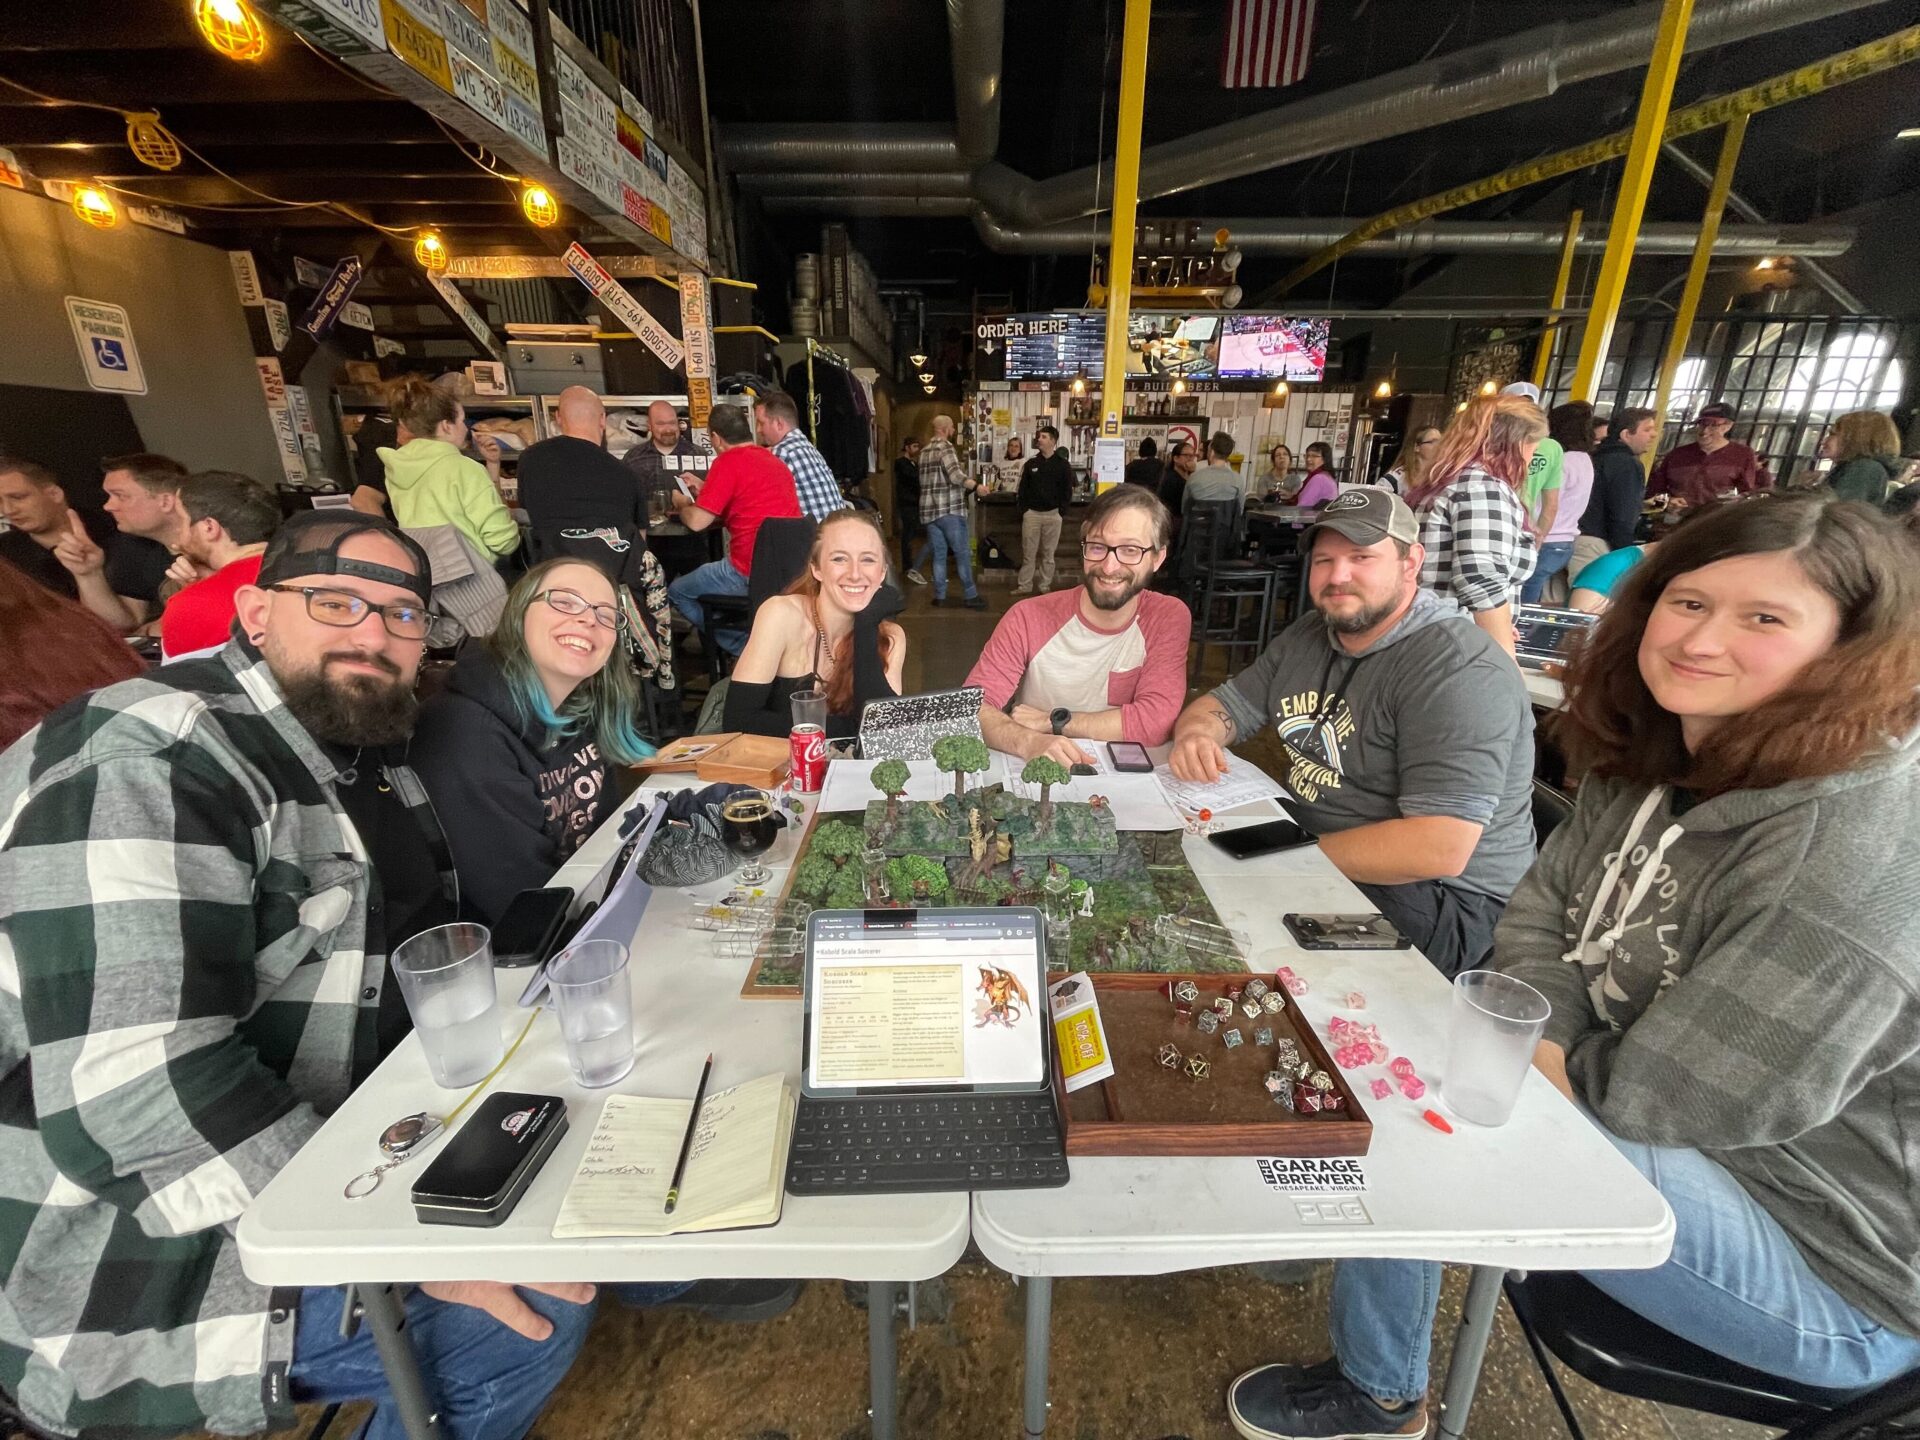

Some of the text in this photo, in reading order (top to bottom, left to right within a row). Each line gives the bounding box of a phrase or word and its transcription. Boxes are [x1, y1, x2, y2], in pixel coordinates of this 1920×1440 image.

[565, 249, 585, 273] ECB
[582, 266, 607, 291] 8097
[306, 262, 356, 333] Genuine Ford Parts
[72, 304, 123, 325] RESERVED
[80, 320, 125, 339] PARKING
[977, 319, 1068, 339] ORDER HERE
[260, 364, 277, 401] FARM
[271, 370, 285, 395] USE
[1188, 382, 1220, 392] BEER
[1141, 427, 1165, 437] ROADWAY
[857, 947, 881, 955] Sorcerer
[1075, 1020, 1090, 1041] 10%
[1079, 1042, 1097, 1059] OFF
[1257, 1159, 1278, 1185] THE
[1271, 1159, 1363, 1173] GARAGE
[1277, 1173, 1366, 1185] BREWERY
